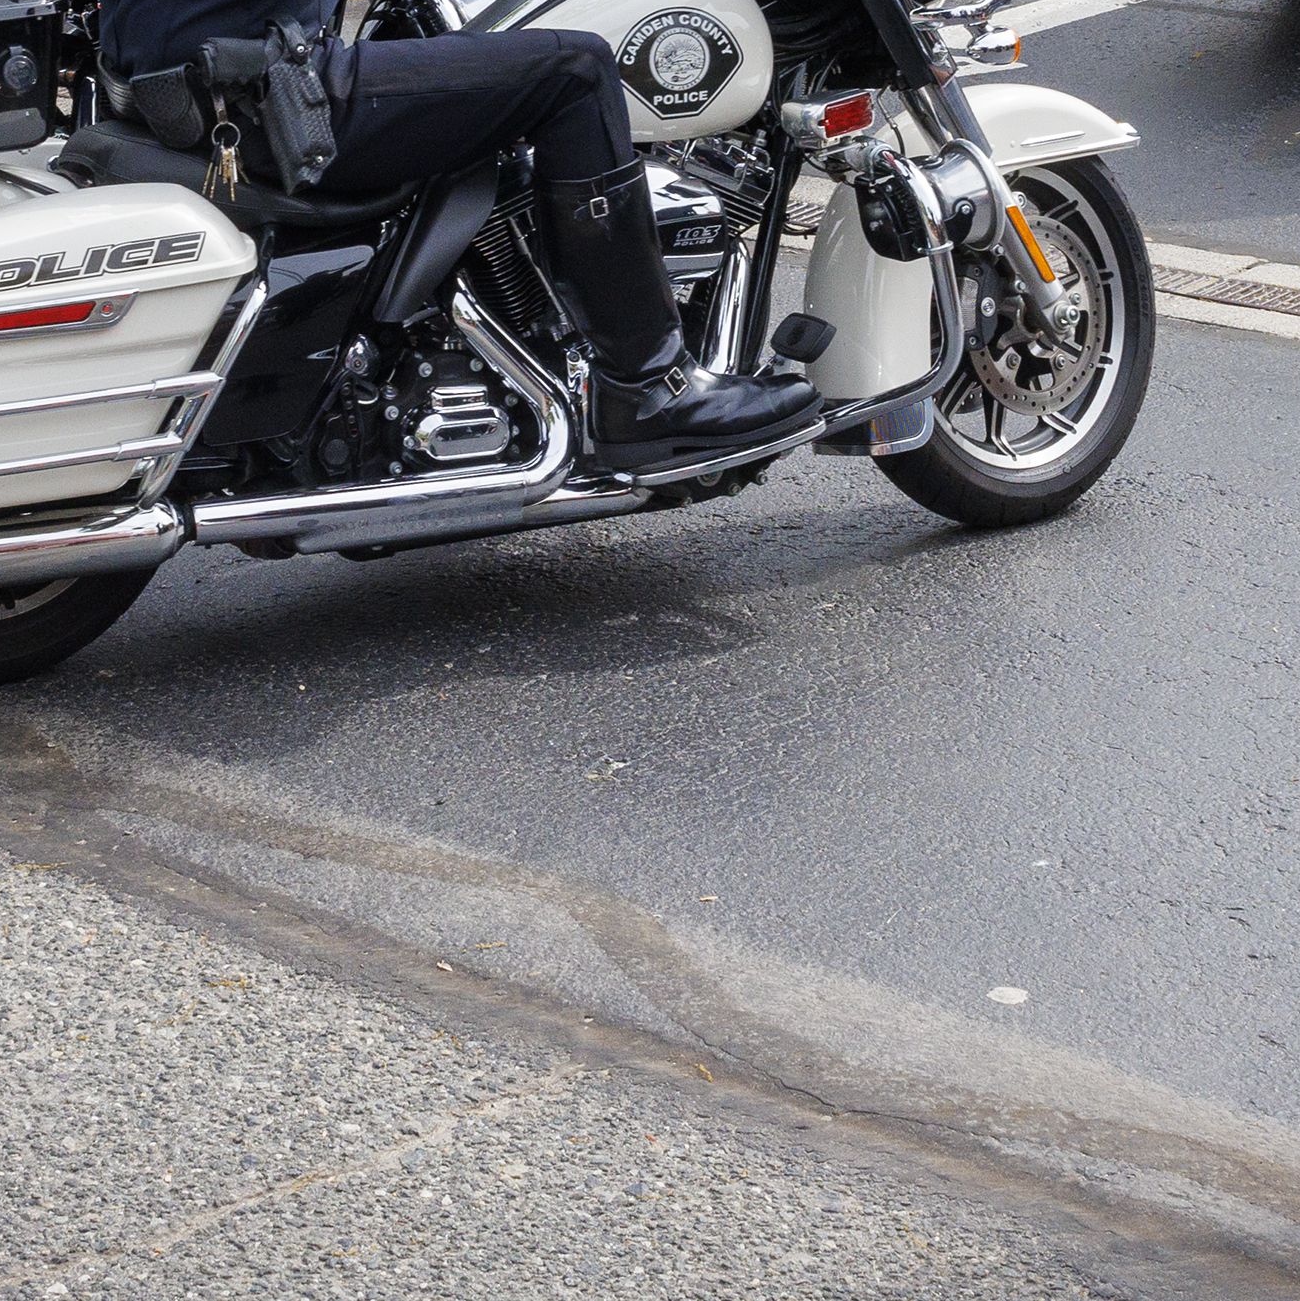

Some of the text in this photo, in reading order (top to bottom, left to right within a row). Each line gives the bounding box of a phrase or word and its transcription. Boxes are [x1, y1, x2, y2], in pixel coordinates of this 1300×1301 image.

[622, 14, 733, 65] CAMDEN COUNTY
[653, 90, 709, 106] POLICE
[676, 225, 722, 241] 103
[673, 238, 715, 248] POLICE
